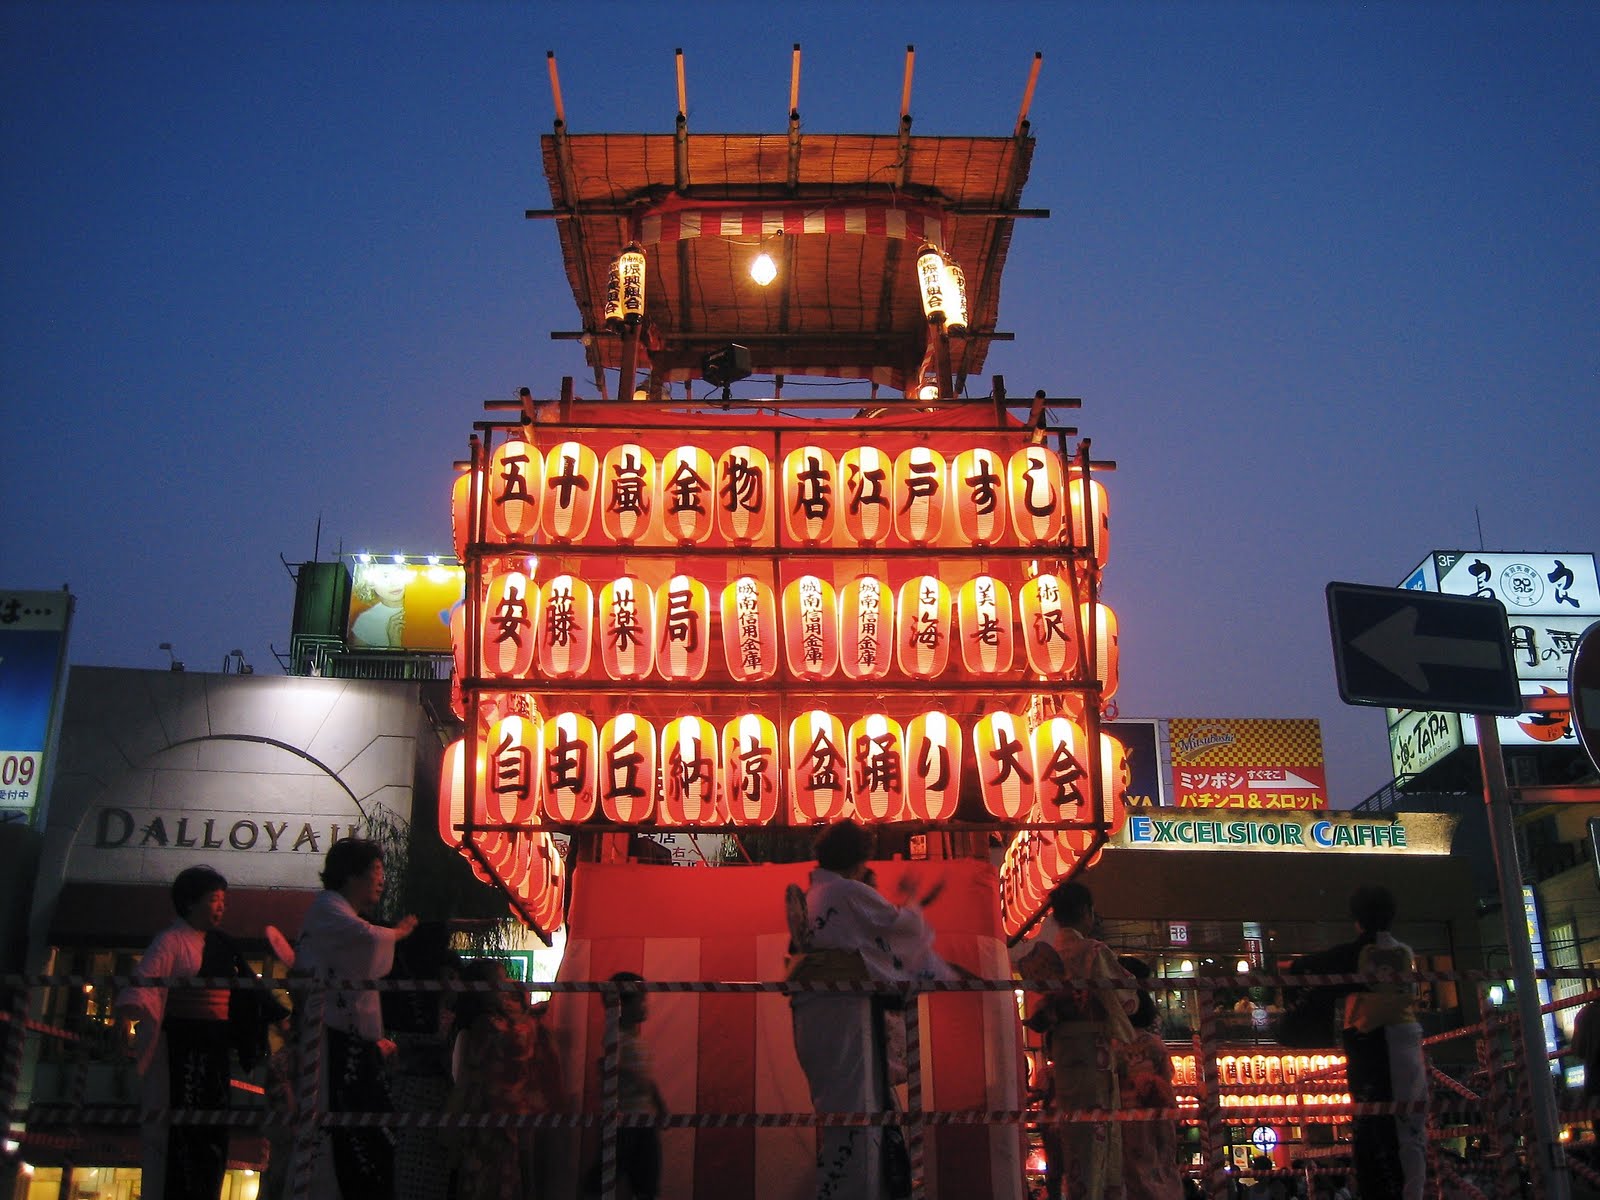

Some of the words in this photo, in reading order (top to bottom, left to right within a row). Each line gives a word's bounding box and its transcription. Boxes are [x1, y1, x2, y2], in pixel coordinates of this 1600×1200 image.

[1437, 555, 1455, 567] 3F
[739, 583, 764, 670] 城南信用金庫
[801, 581, 824, 665] 城南信用金庫
[856, 584, 880, 667] 城南信用金庫
[1177, 733, 1235, 754] Mitsuboshi
[1413, 713, 1449, 753] TAPA
[1180, 772, 1244, 790] ミツボシ
[1247, 770, 1281, 780] すぐそこ
[1130, 816, 1302, 845] EXCELSIOR
[1313, 820, 1407, 847] CAFFÉ
